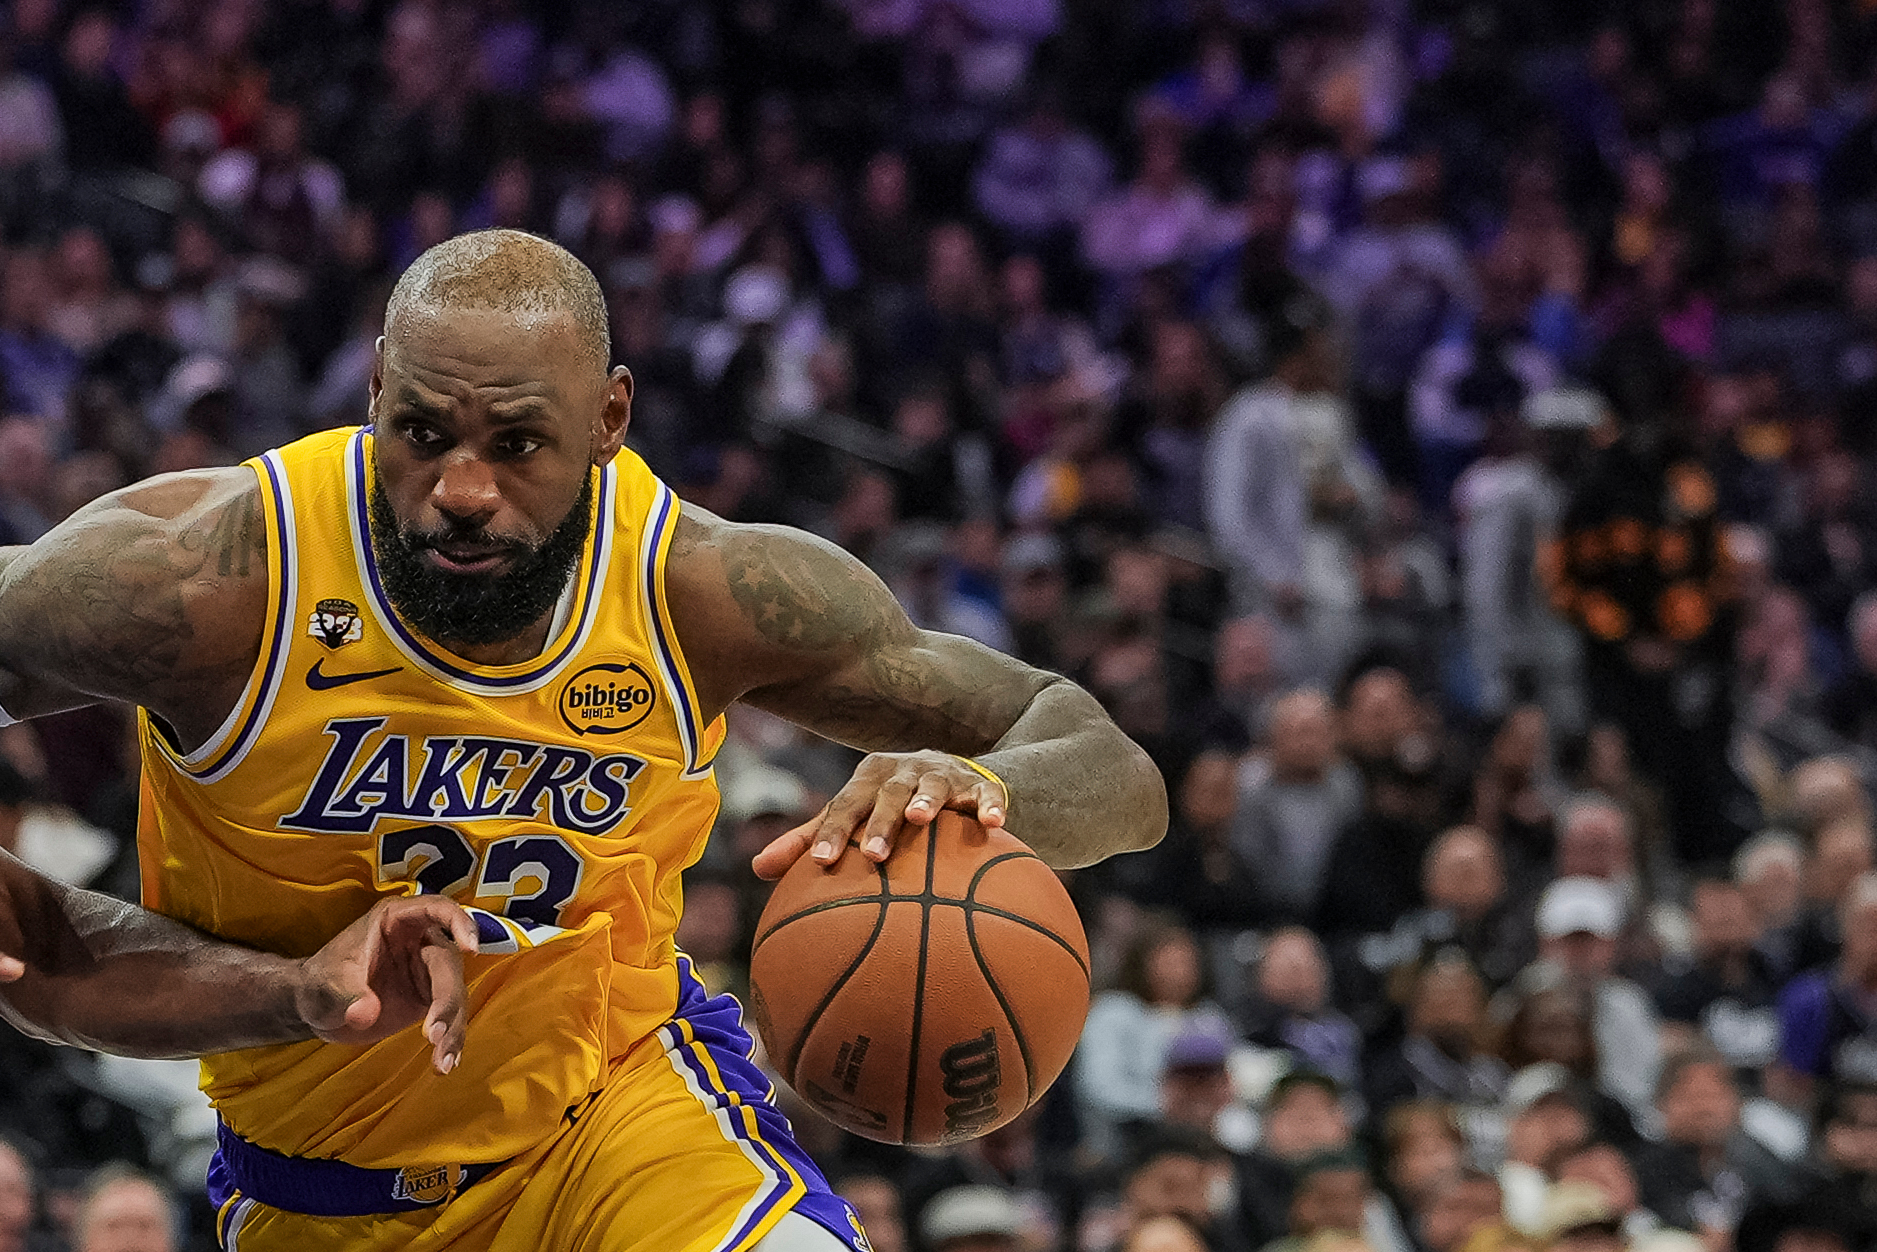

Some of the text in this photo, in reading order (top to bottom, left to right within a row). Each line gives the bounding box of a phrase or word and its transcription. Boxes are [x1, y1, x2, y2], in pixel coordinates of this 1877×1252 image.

[568, 682, 650, 713] bibigo
[581, 706, 615, 720] 비비고
[276, 716, 648, 838] LAKERS
[391, 1168, 454, 1199] LAKER
